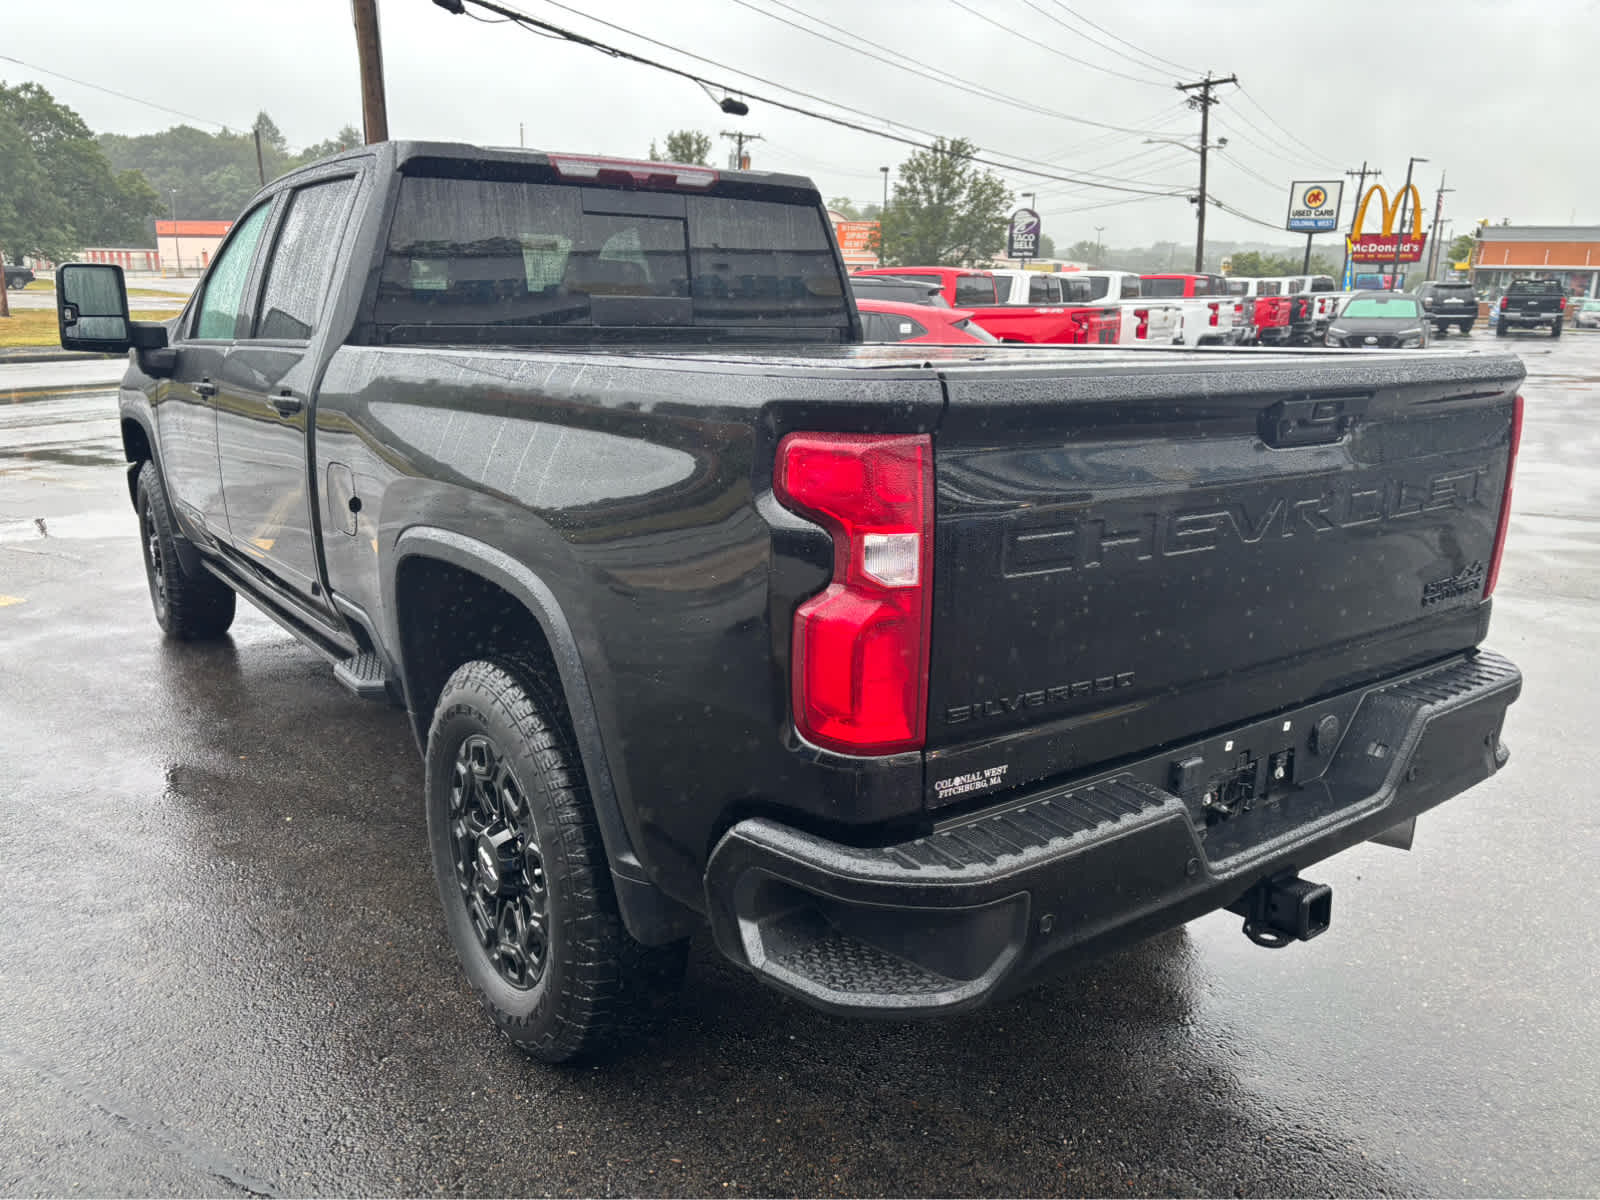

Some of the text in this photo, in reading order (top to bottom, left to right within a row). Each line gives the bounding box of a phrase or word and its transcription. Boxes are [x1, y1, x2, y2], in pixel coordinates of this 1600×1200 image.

[1292, 209, 1334, 217] USED CARS
[1012, 233, 1035, 241] TACO
[1013, 241, 1034, 249] BELL
[1001, 466, 1488, 578] CHEVROLET
[945, 671, 1136, 725] SILVERADO
[935, 764, 1009, 790] COLONIAL WEST
[989, 775, 1002, 786] MA
